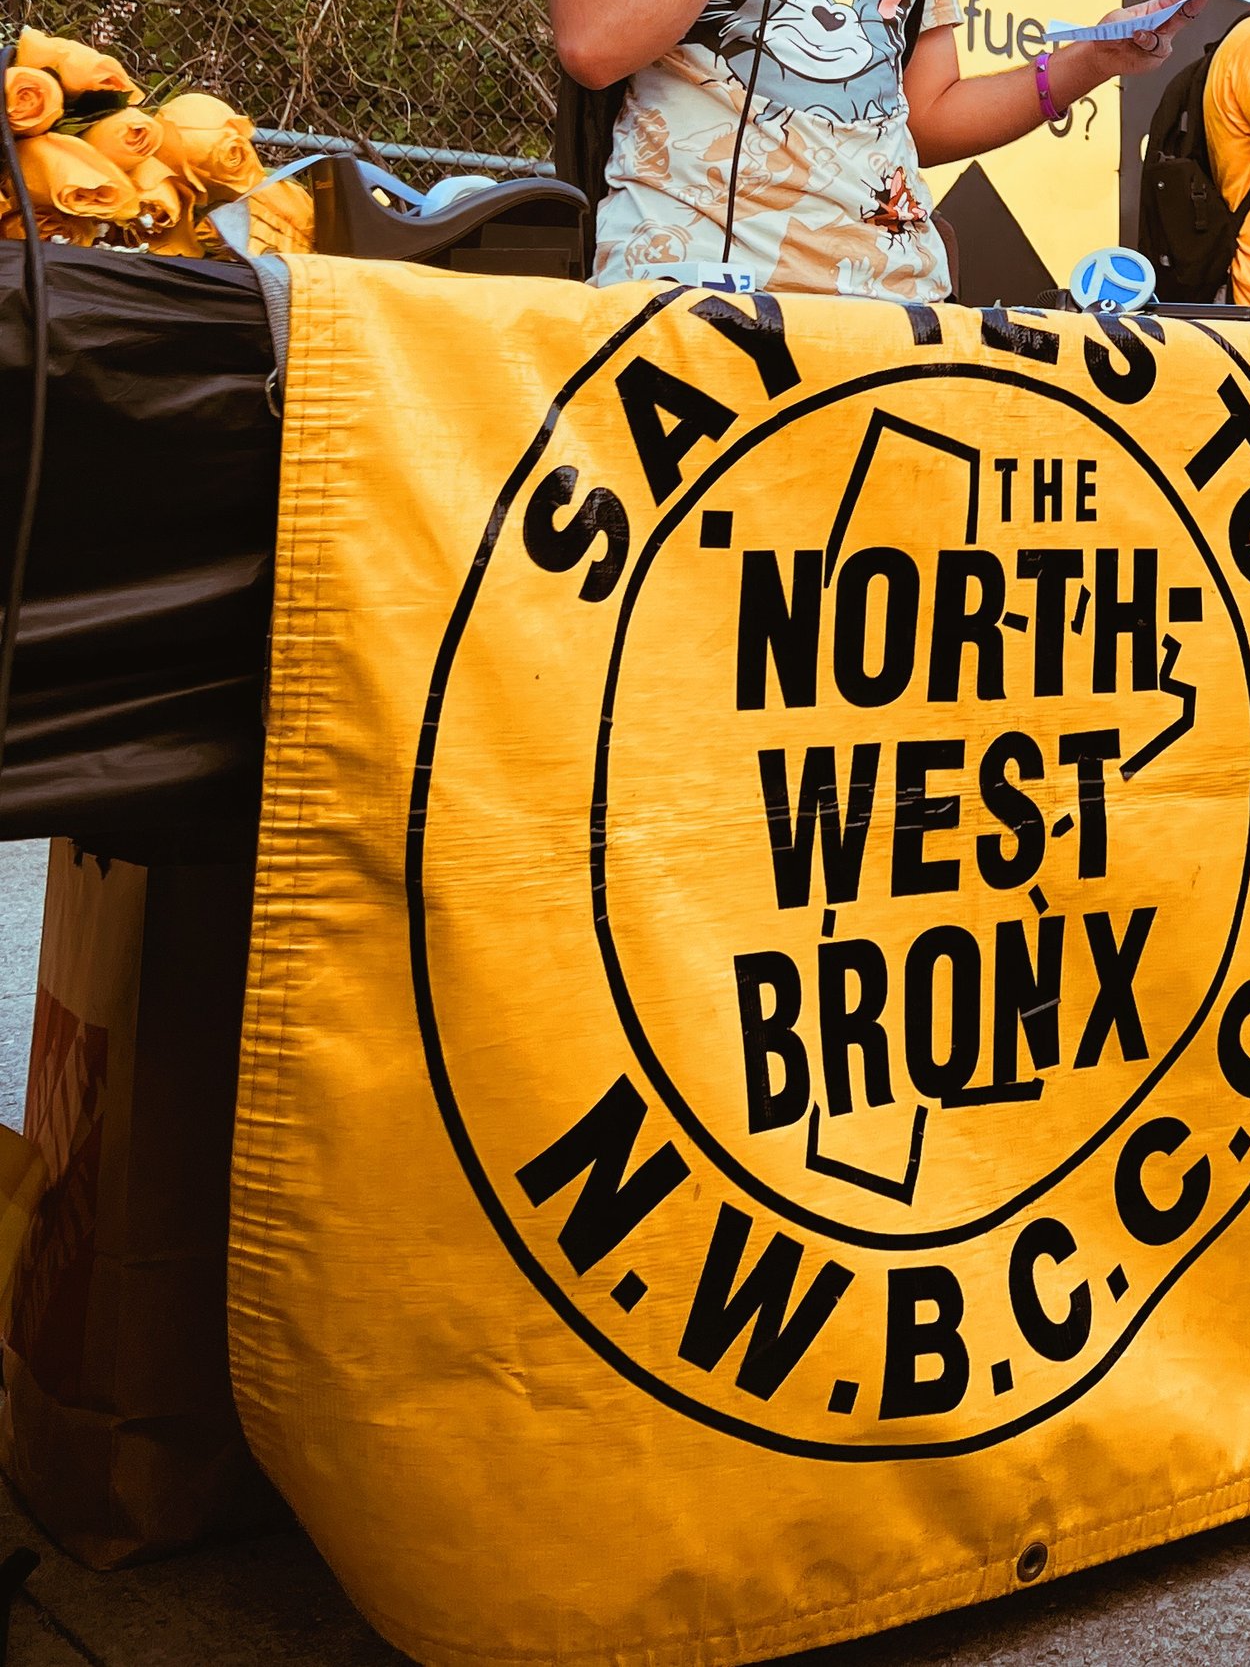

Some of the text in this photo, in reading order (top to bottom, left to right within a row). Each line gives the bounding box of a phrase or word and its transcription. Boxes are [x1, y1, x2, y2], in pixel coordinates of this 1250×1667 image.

[524, 292, 802, 603] SAY
[994, 458, 1097, 522] THE
[737, 546, 1158, 711] NORTH
[758, 728, 1121, 910] WEST
[733, 906, 1158, 1135] BRONX
